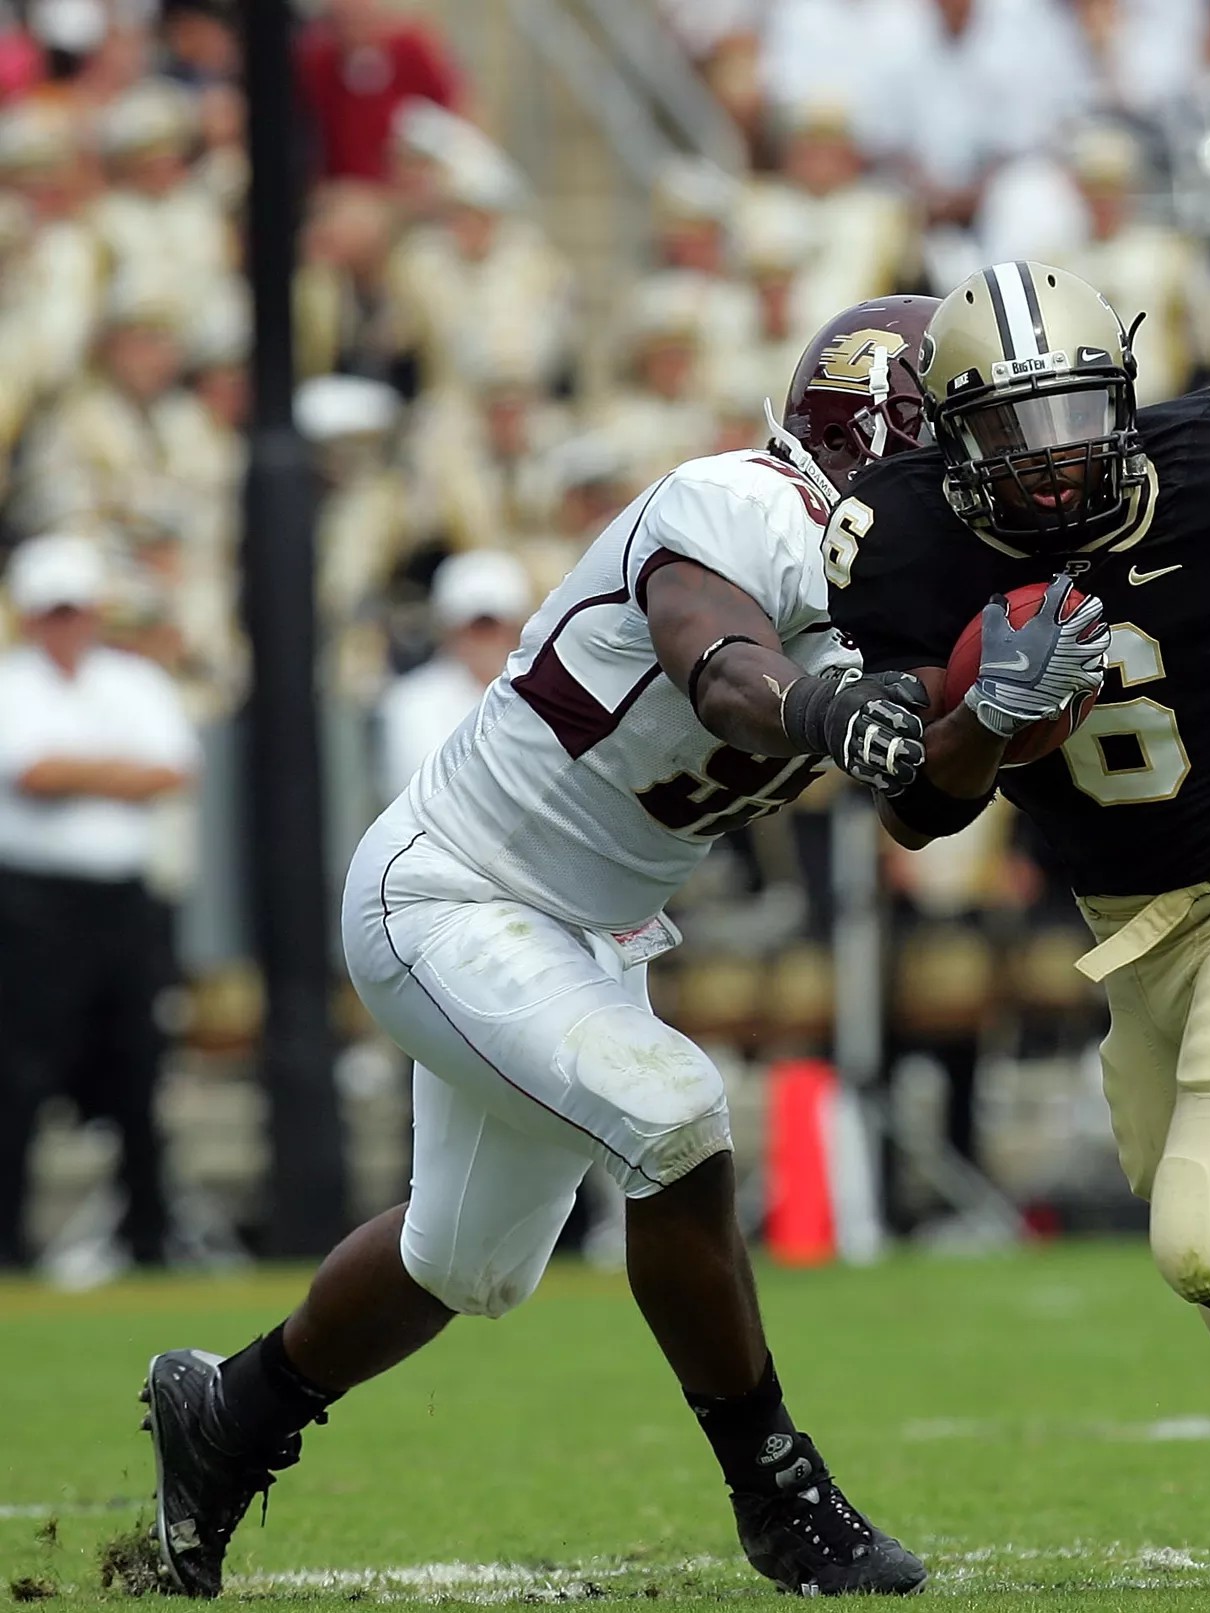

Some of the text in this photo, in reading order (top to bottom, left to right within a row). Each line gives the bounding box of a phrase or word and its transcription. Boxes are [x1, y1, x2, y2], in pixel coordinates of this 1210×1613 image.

[808, 465, 834, 497] DAMS
[821, 496, 875, 590] 6
[1060, 621, 1192, 807] 6
